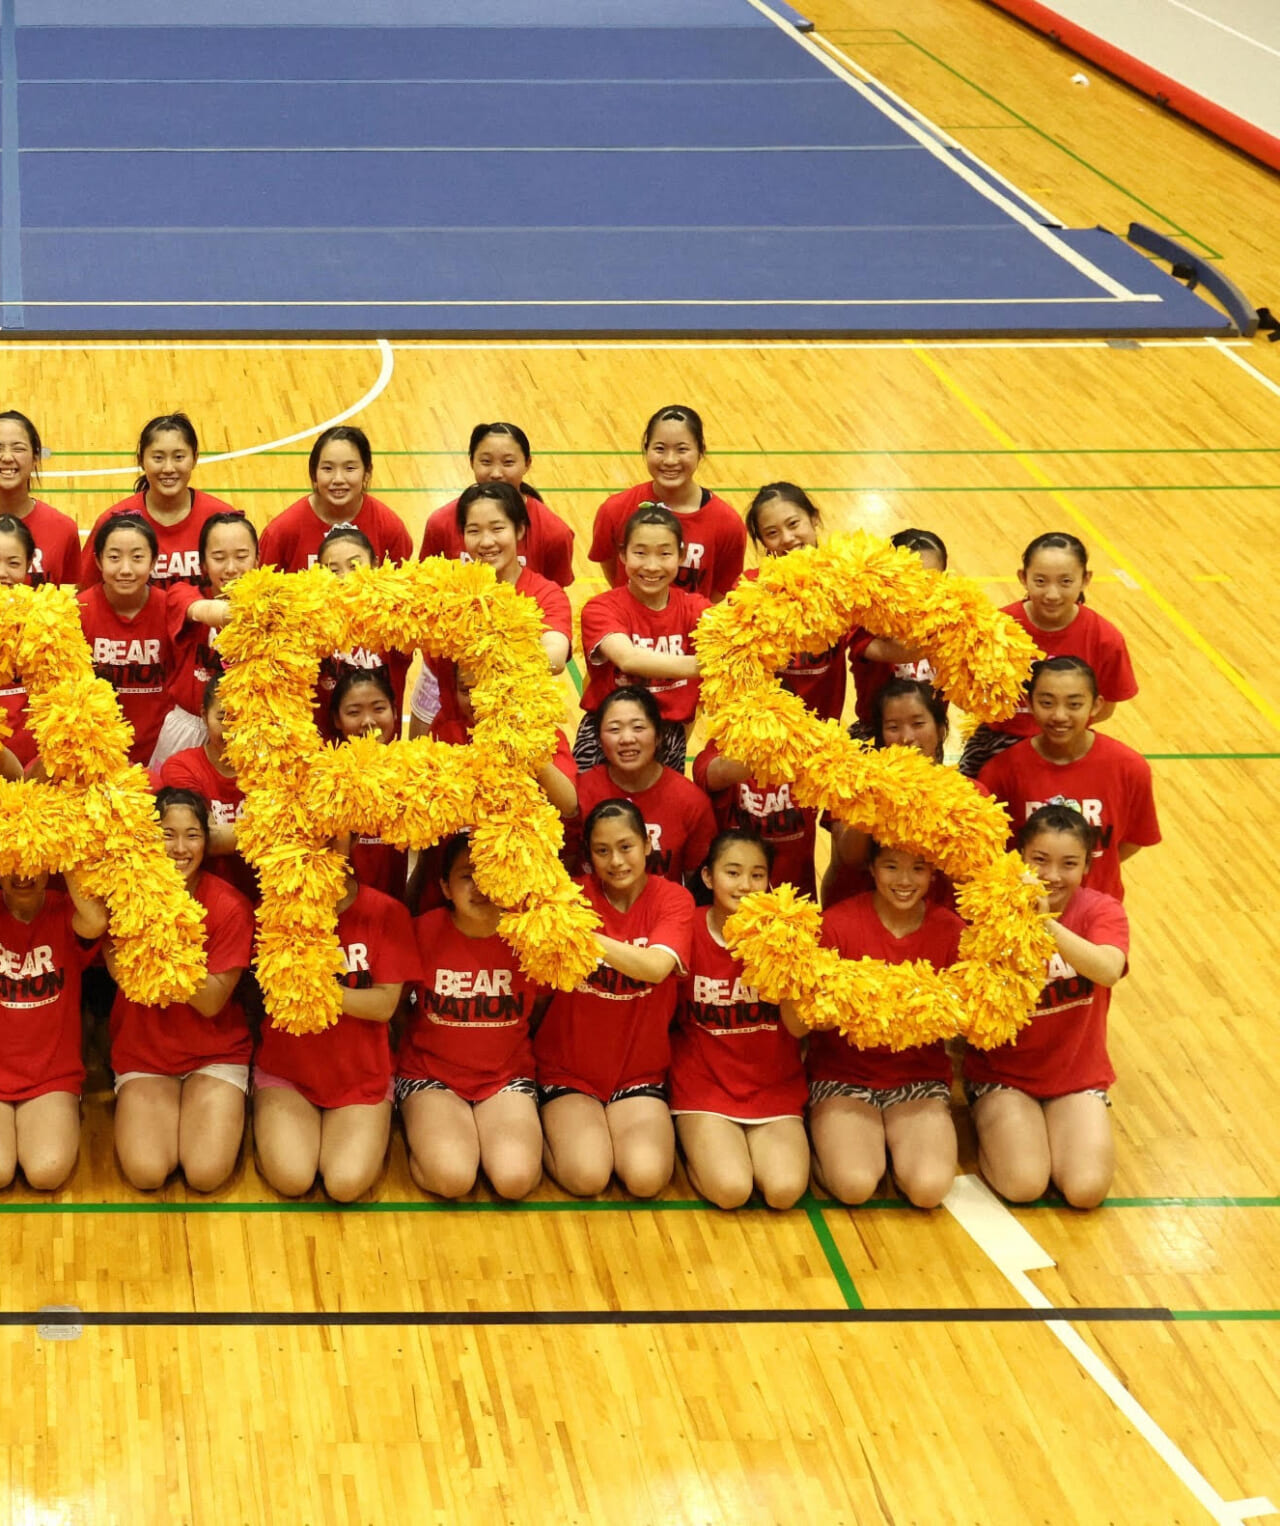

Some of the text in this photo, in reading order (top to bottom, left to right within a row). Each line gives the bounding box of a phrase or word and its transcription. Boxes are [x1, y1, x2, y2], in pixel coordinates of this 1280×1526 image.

[150, 550, 202, 579] EAR
[94, 637, 161, 665] BEAR
[94, 663, 168, 686] ATION
[209, 799, 247, 826] BE
[434, 969, 514, 999] BEAR
[423, 988, 524, 1022] NATION
